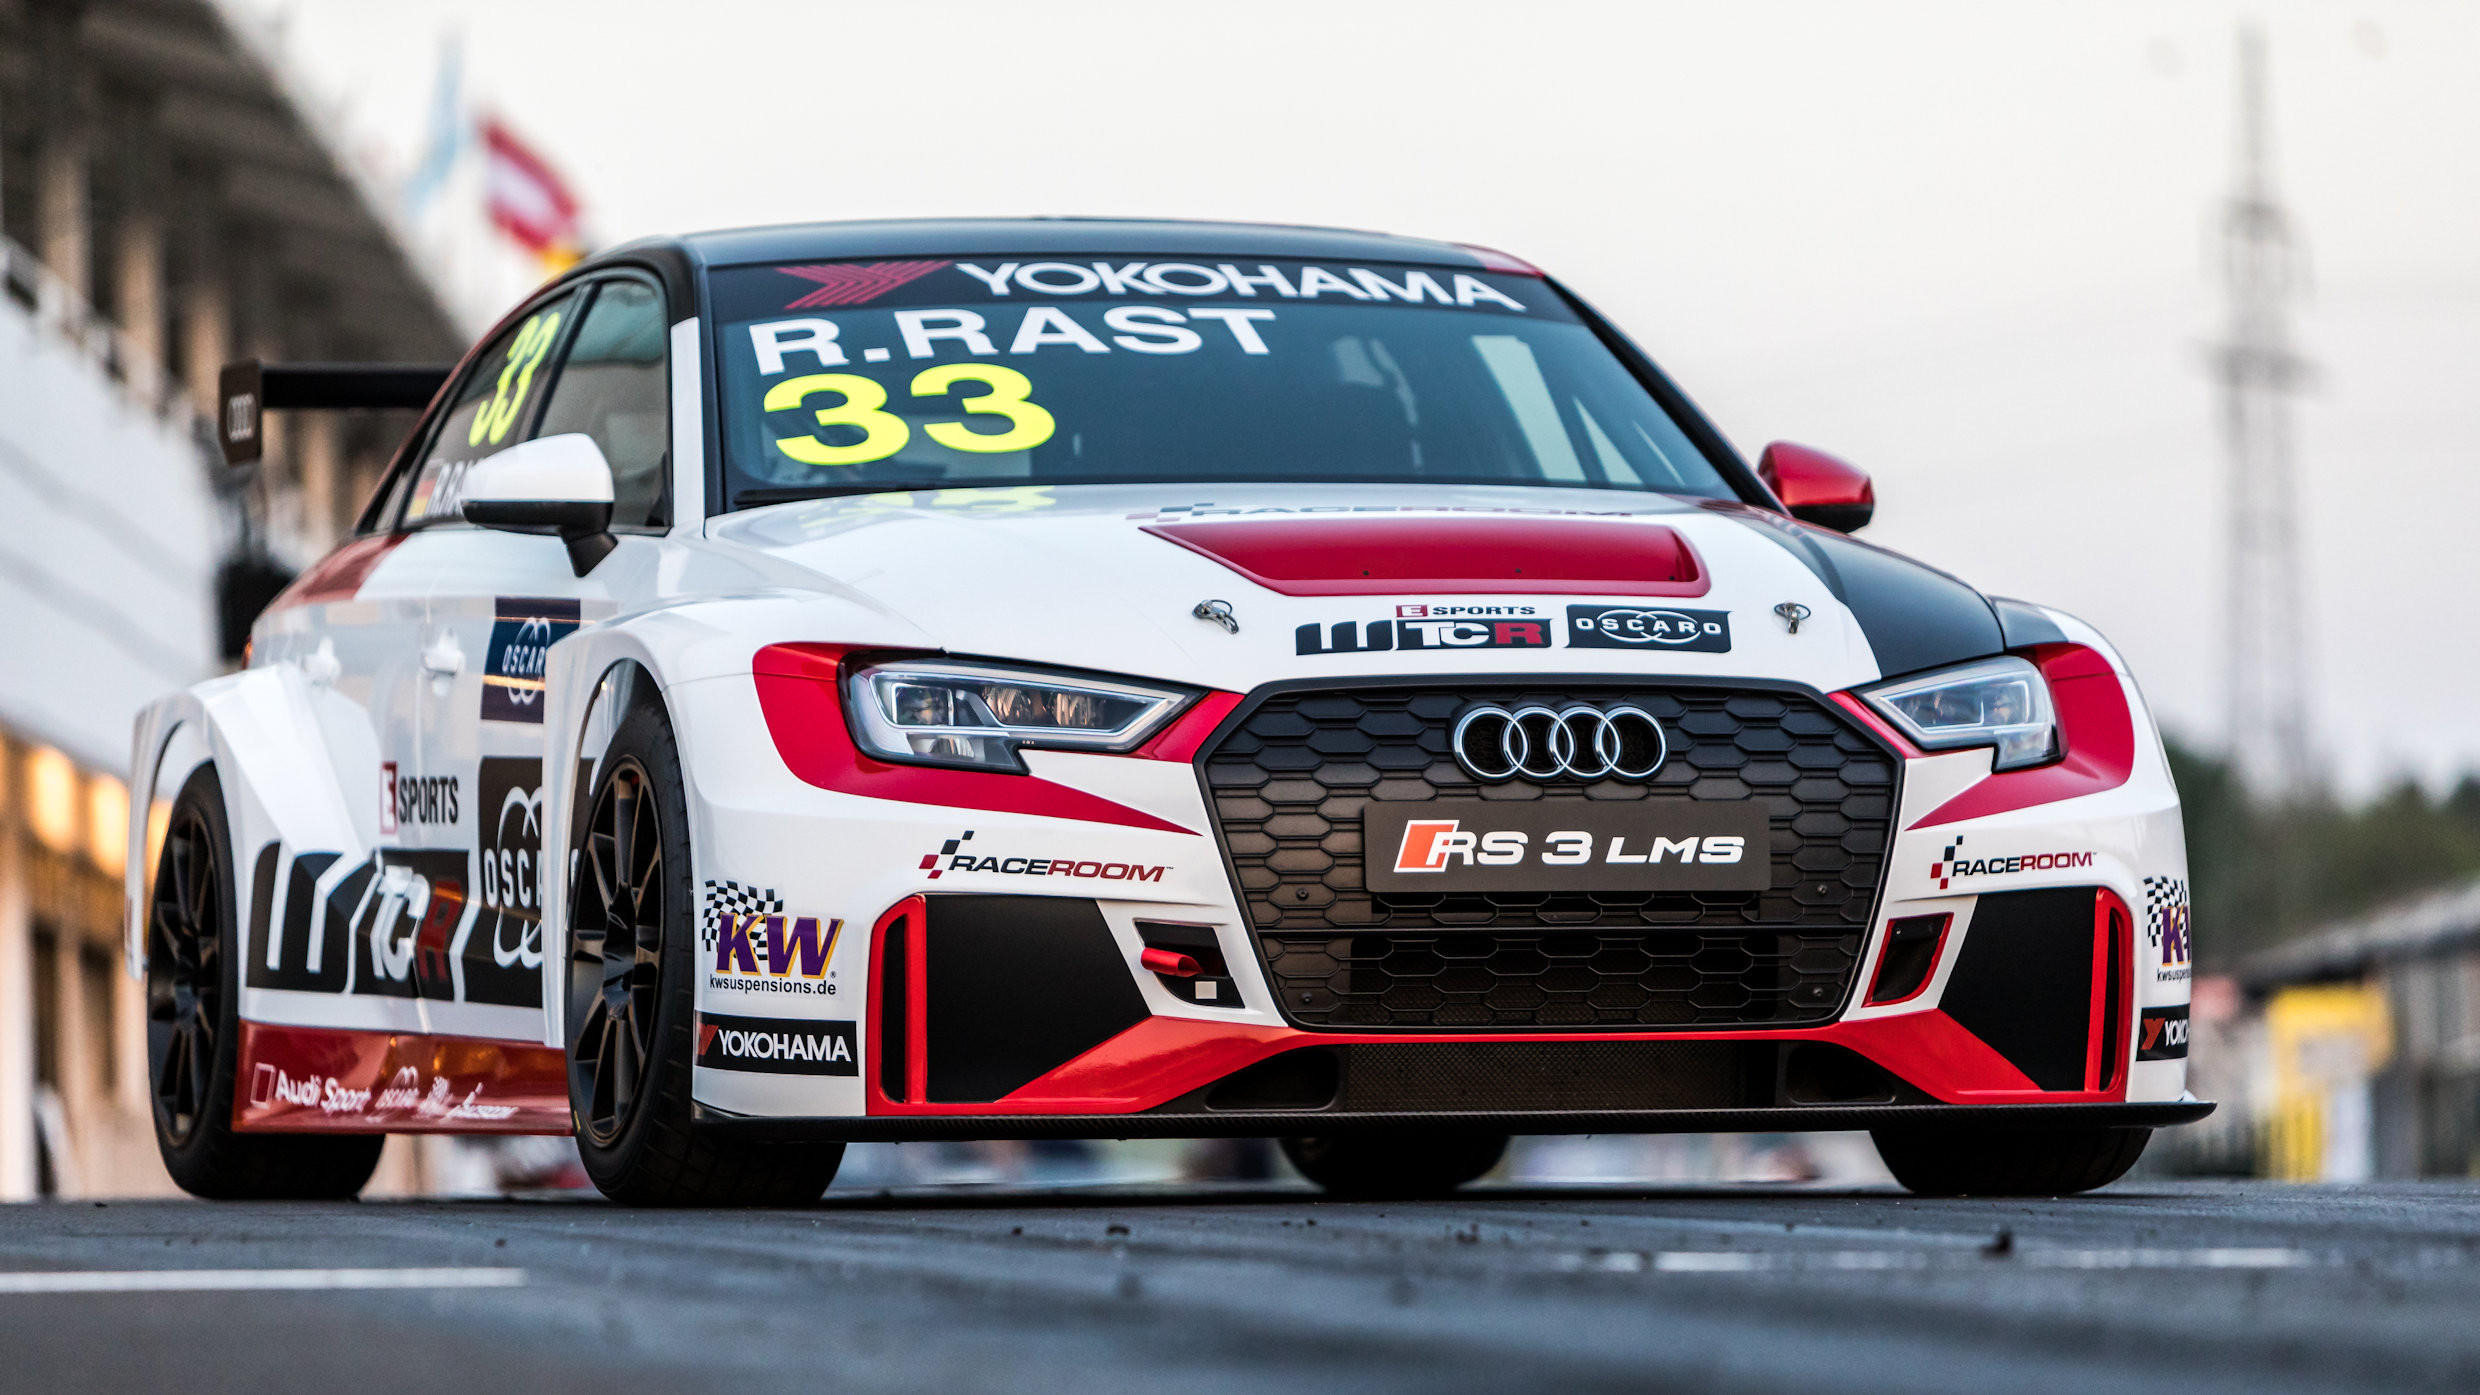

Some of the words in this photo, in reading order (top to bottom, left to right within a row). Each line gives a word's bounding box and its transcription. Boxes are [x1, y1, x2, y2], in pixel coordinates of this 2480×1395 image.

[955, 262, 1527, 312] YOKOHAMA
[749, 306, 1276, 376] R.RAST
[467, 312, 560, 447] 33
[763, 363, 1056, 466] 33
[1575, 617, 1722, 635] OSCARO
[502, 644, 546, 674] OSCAR
[1425, 831, 1529, 866] RS
[1541, 830, 1593, 865] 3
[1605, 836, 1745, 863] LMS
[1952, 852, 2093, 877] RACEROOM
[948, 855, 1165, 882] RACEROOM
[716, 912, 844, 978] KW
[709, 977, 837, 997] kwsuspensions.de
[718, 1029, 852, 1062] YOKOHAMA
[2164, 1018, 2190, 1048] YOKO
[275, 1069, 320, 1108] Audi
[320, 1077, 371, 1116] Sport
